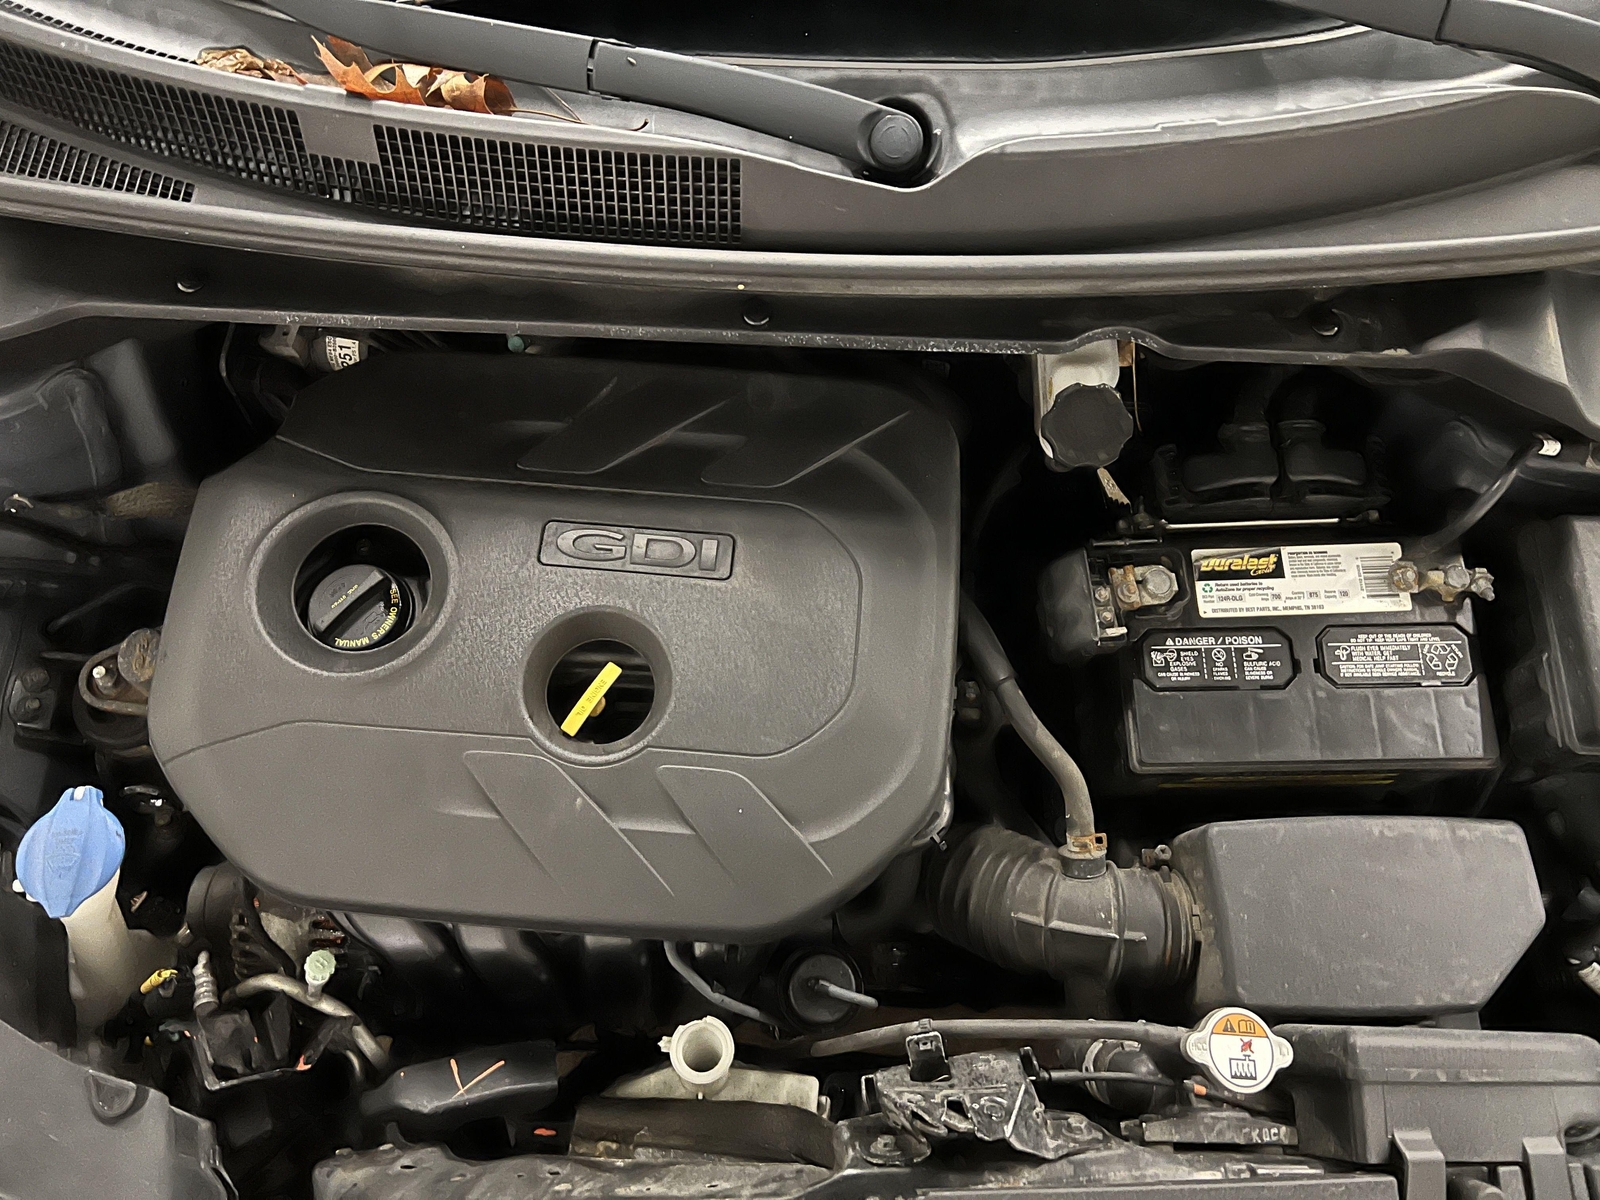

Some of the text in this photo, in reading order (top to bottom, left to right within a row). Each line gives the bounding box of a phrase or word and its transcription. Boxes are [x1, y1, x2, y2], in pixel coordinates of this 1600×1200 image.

[556, 528, 718, 571] GDI
[390, 588, 398, 604] SEE
[372, 606, 398, 640] OWNER'S
[334, 637, 369, 648] MANUAL
[1175, 636, 1216, 645] DANGER
[1225, 636, 1262, 644] POISON
[575, 679, 607, 716] ENGINE OIL
